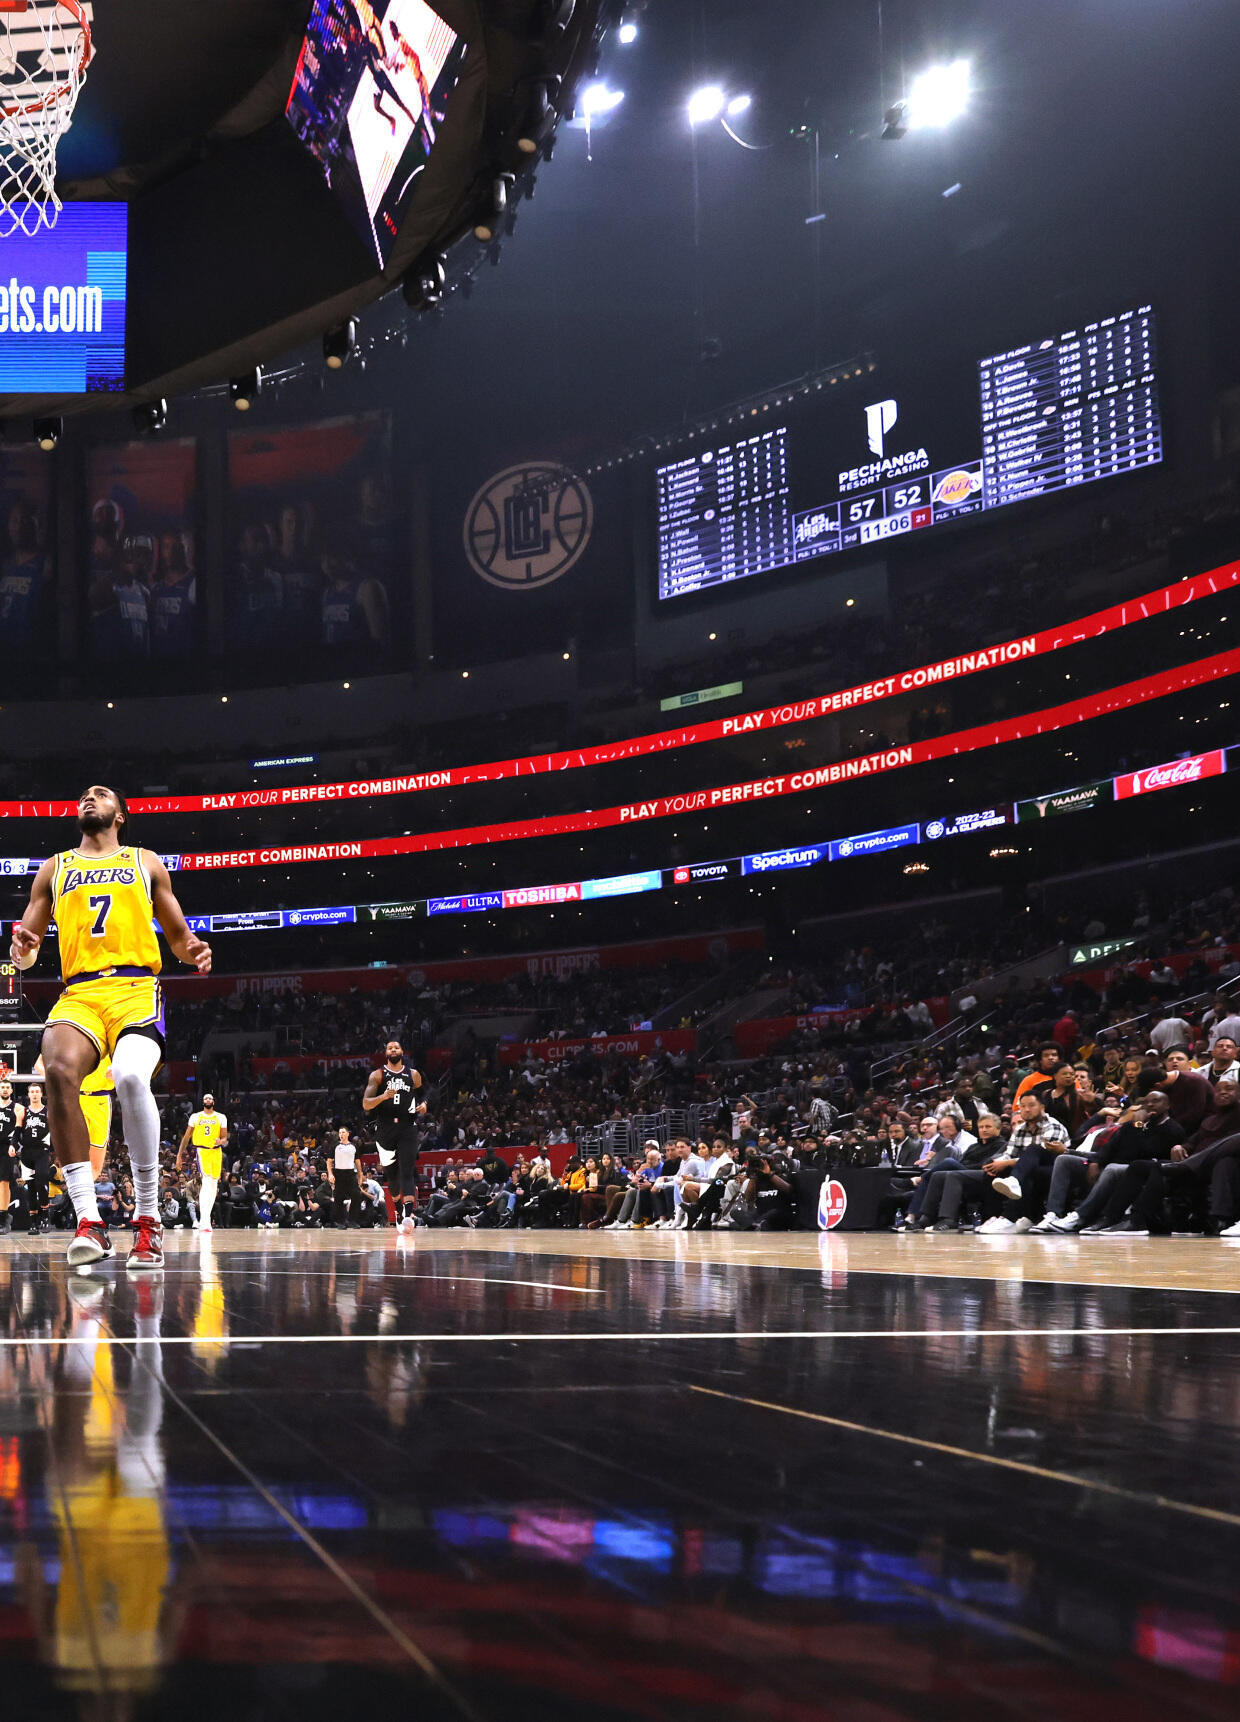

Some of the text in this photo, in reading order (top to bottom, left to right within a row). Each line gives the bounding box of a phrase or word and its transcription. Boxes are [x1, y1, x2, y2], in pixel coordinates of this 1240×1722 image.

[839, 448, 928, 484] PECHANGA
[839, 460, 929, 492] RESORT CASINO
[894, 485, 922, 508] 52
[849, 498, 876, 521] 57
[915, 513, 927, 524] 21
[862, 516, 910, 540] 11:06
[843, 533, 858, 544] 3rd
[723, 638, 1037, 734] PLAY YOUR PERFECT COMBINATION
[253, 756, 314, 768] AMERICAN EXPRESS
[202, 772, 451, 809] PLAY YOUR PERFECT COMBINATION
[620, 748, 912, 821] PLAY YOUR PERFECT COMBINATION
[946, 816, 1005, 836] LA CLIPPERS
[955, 810, 995, 825] 2022-23
[854, 831, 909, 851] crypto.com
[195, 851, 255, 868] PERFECT
[260, 843, 361, 863] COMBINATION
[752, 849, 818, 872] Spectrum
[19, 864, 26, 874] 3
[691, 865, 728, 878] TOYOTA
[61, 867, 136, 896] LAKERS
[467, 896, 500, 908] ULTRA
[506, 885, 578, 905] TOSHIBA
[88, 894, 112, 937] 7
[302, 910, 347, 922] crypto.com
[393, 1094, 400, 1104] 8
[32, 1128, 37, 1137] 5
[204, 1125, 210, 1136] 3
